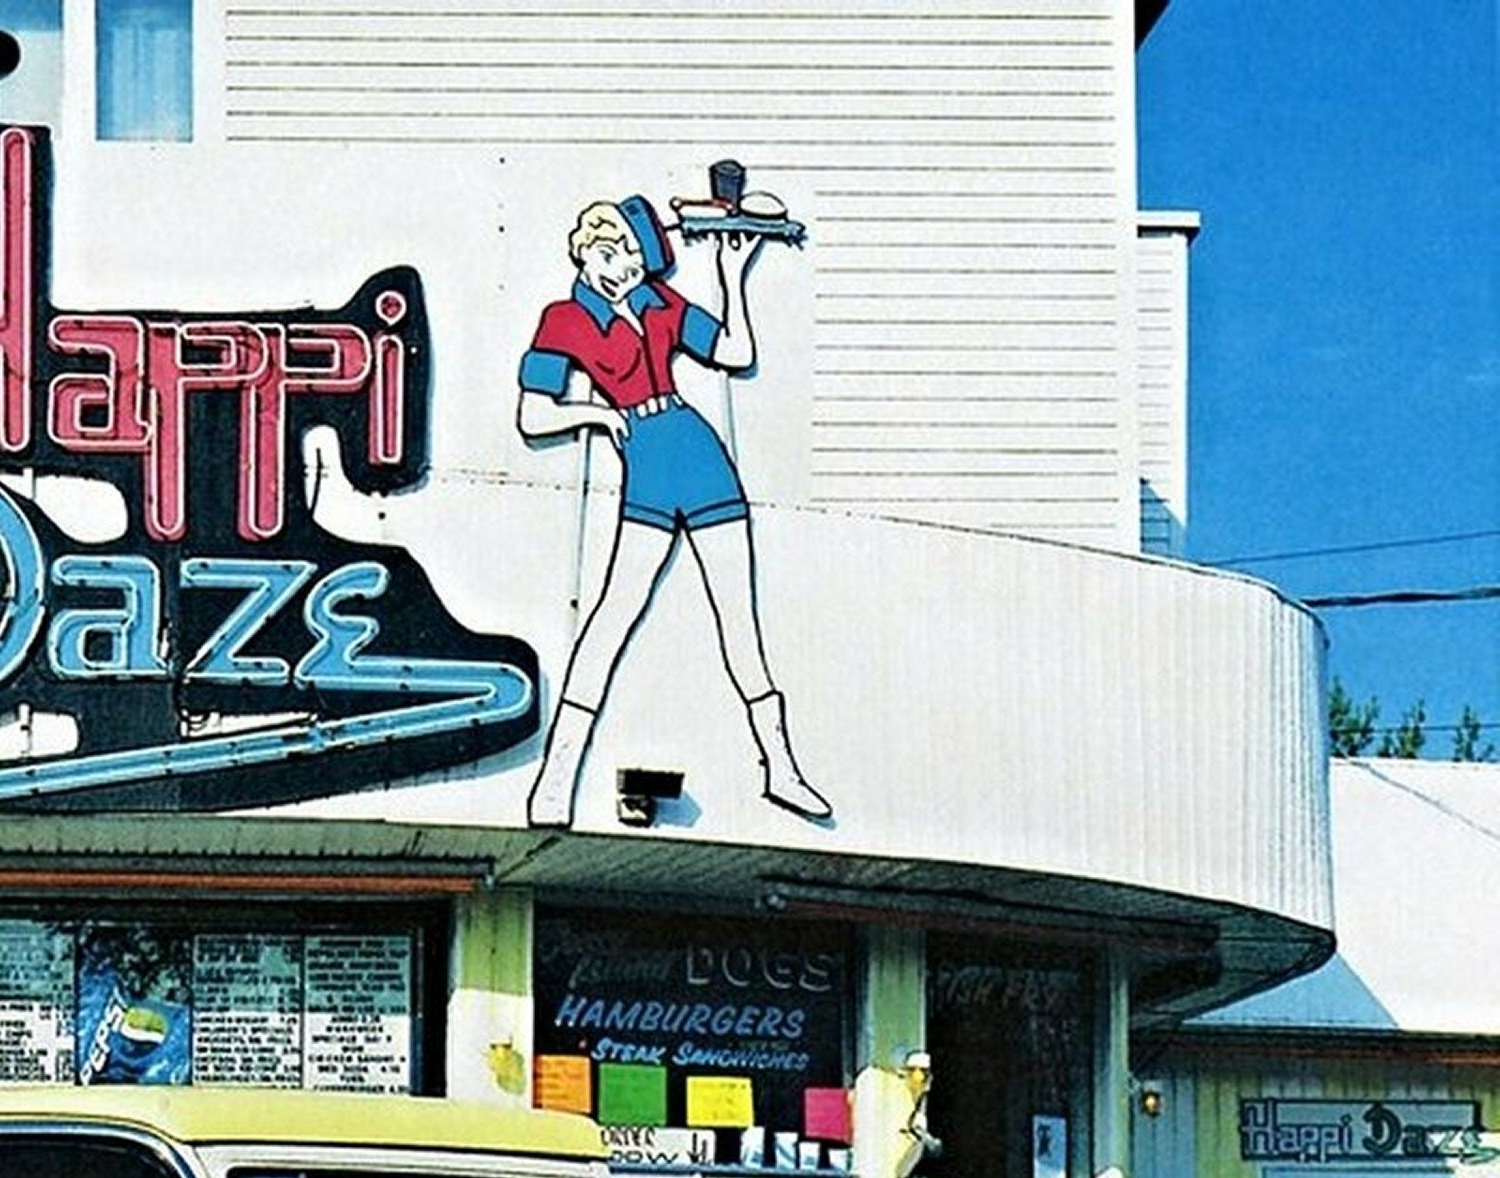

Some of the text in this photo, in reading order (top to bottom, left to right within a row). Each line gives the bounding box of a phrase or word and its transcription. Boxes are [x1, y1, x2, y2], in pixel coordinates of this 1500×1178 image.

[686, 944, 835, 992] DOGS
[554, 993, 806, 1038] HAMBURGERS
[590, 1036, 811, 1070] STEAK SANDWICHES
[1240, 1099, 1354, 1163] Happi
